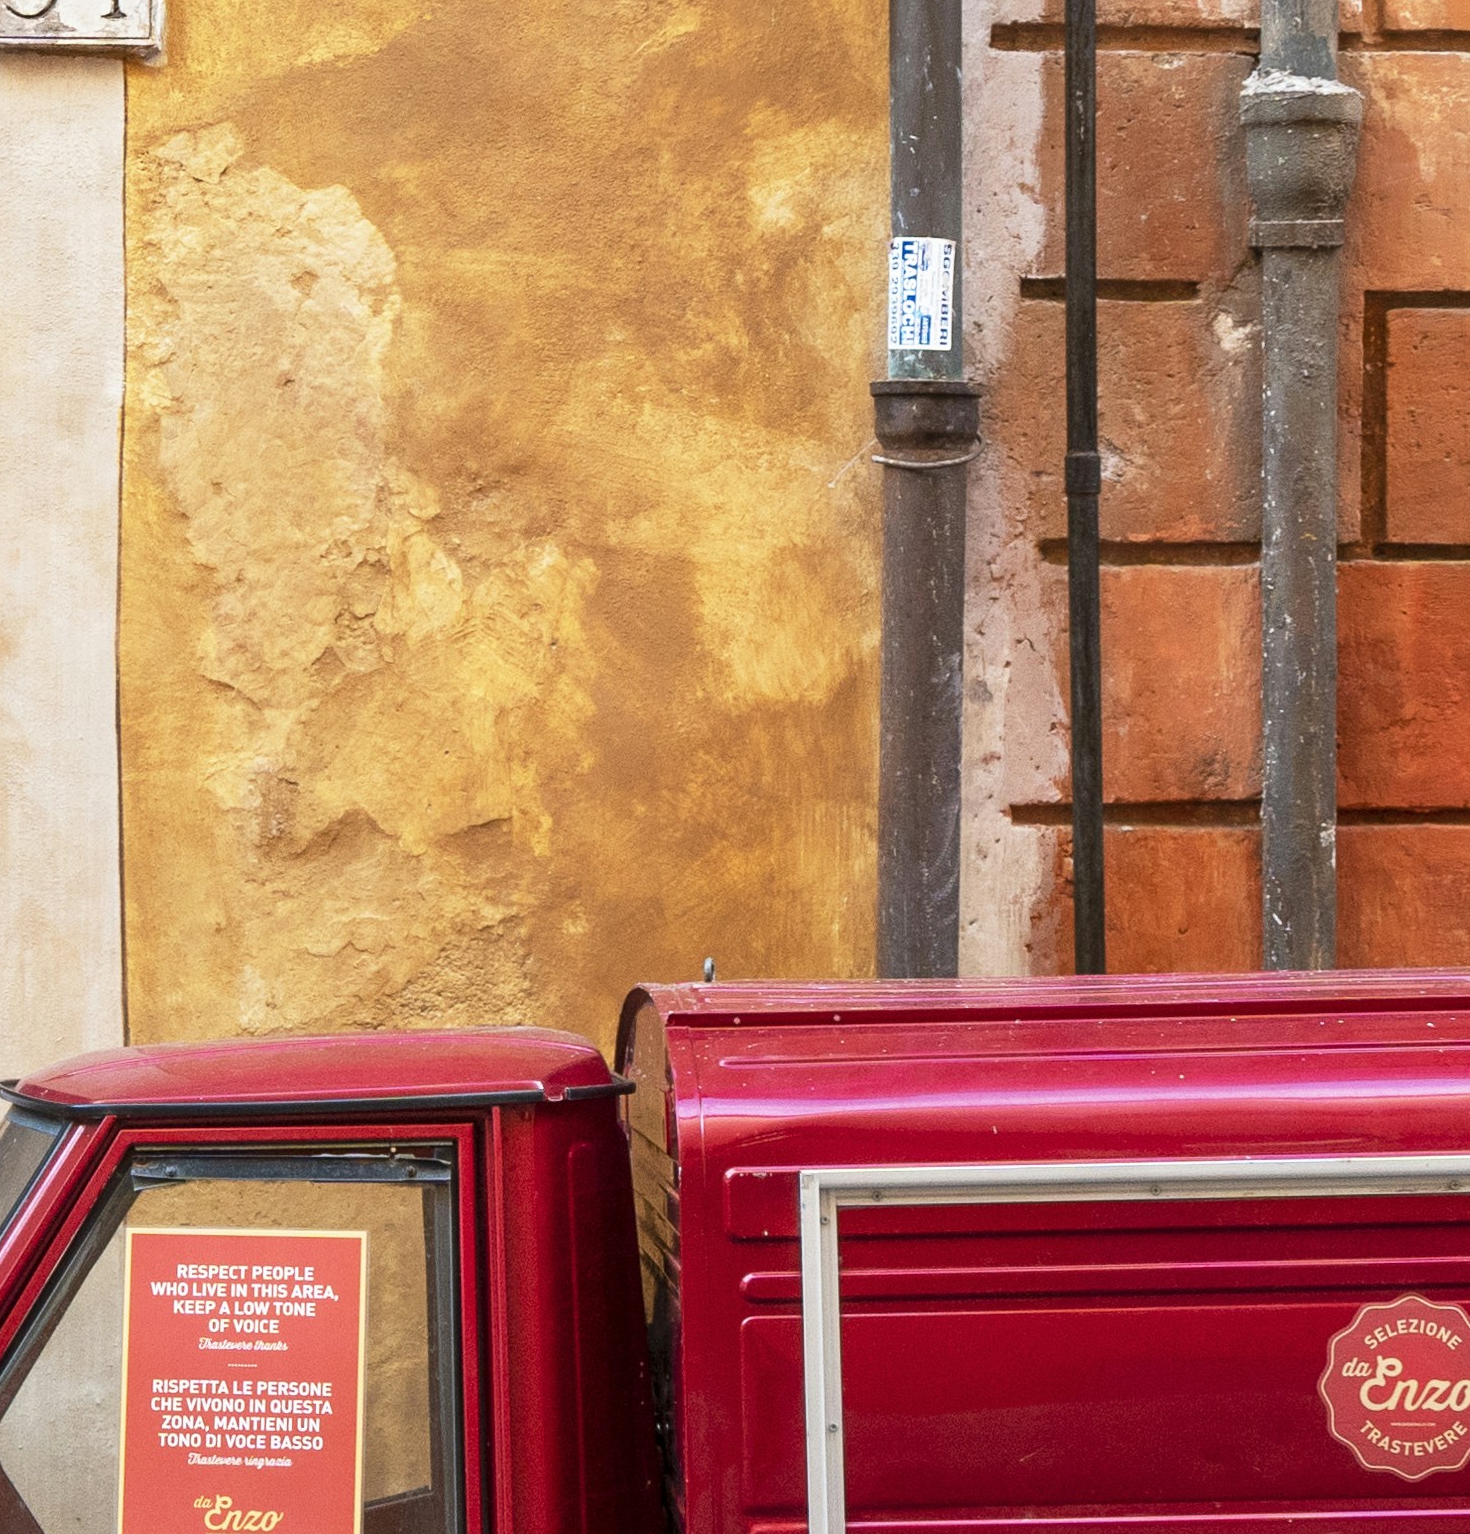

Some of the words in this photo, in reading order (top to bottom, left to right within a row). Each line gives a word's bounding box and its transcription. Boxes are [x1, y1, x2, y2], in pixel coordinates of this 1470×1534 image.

[900, 241, 918, 345] TRASLOCHI
[176, 1263, 249, 1280] RESPECT
[251, 1265, 315, 1282] PEOPLE
[150, 1281, 189, 1297] WHO
[192, 1282, 227, 1298] LIVE
[230, 1283, 248, 1298] IN
[251, 1283, 288, 1299] THIS
[290, 1284, 339, 1302] AREA,
[173, 1299, 216, 1315] KEEP
[218, 1300, 231, 1315] A
[234, 1300, 270, 1316] LOW
[273, 1301, 316, 1317] TONE
[208, 1318, 230, 1333] OF
[233, 1318, 280, 1334] VOICE
[1364, 1318, 1463, 1351] SELEZIONE
[198, 1336, 253, 1351] Trastevere
[254, 1338, 289, 1351] thanks
[1341, 1357, 1372, 1378] da
[152, 1378, 230, 1395] RISPETTA
[232, 1380, 253, 1396] LE
[256, 1380, 333, 1397] PERSONE
[150, 1396, 183, 1412] CHE
[186, 1397, 246, 1413] VIVONO
[249, 1398, 266, 1414] IN
[270, 1399, 333, 1415] QUESTA
[161, 1414, 210, 1432] ZONA,
[213, 1415, 293, 1432] MANTIENI
[296, 1417, 321, 1433] UN
[158, 1432, 202, 1448] TONO
[205, 1433, 222, 1449] DI
[225, 1434, 266, 1449] VOCE
[270, 1435, 324, 1451] BASSO
[1360, 1419, 1469, 1457] TRASTEVERE
[187, 1451, 243, 1466] Trastevere
[244, 1454, 293, 1470] ringrazia
[193, 1495, 213, 1509] da
[204, 1494, 284, 1532] Enzo
